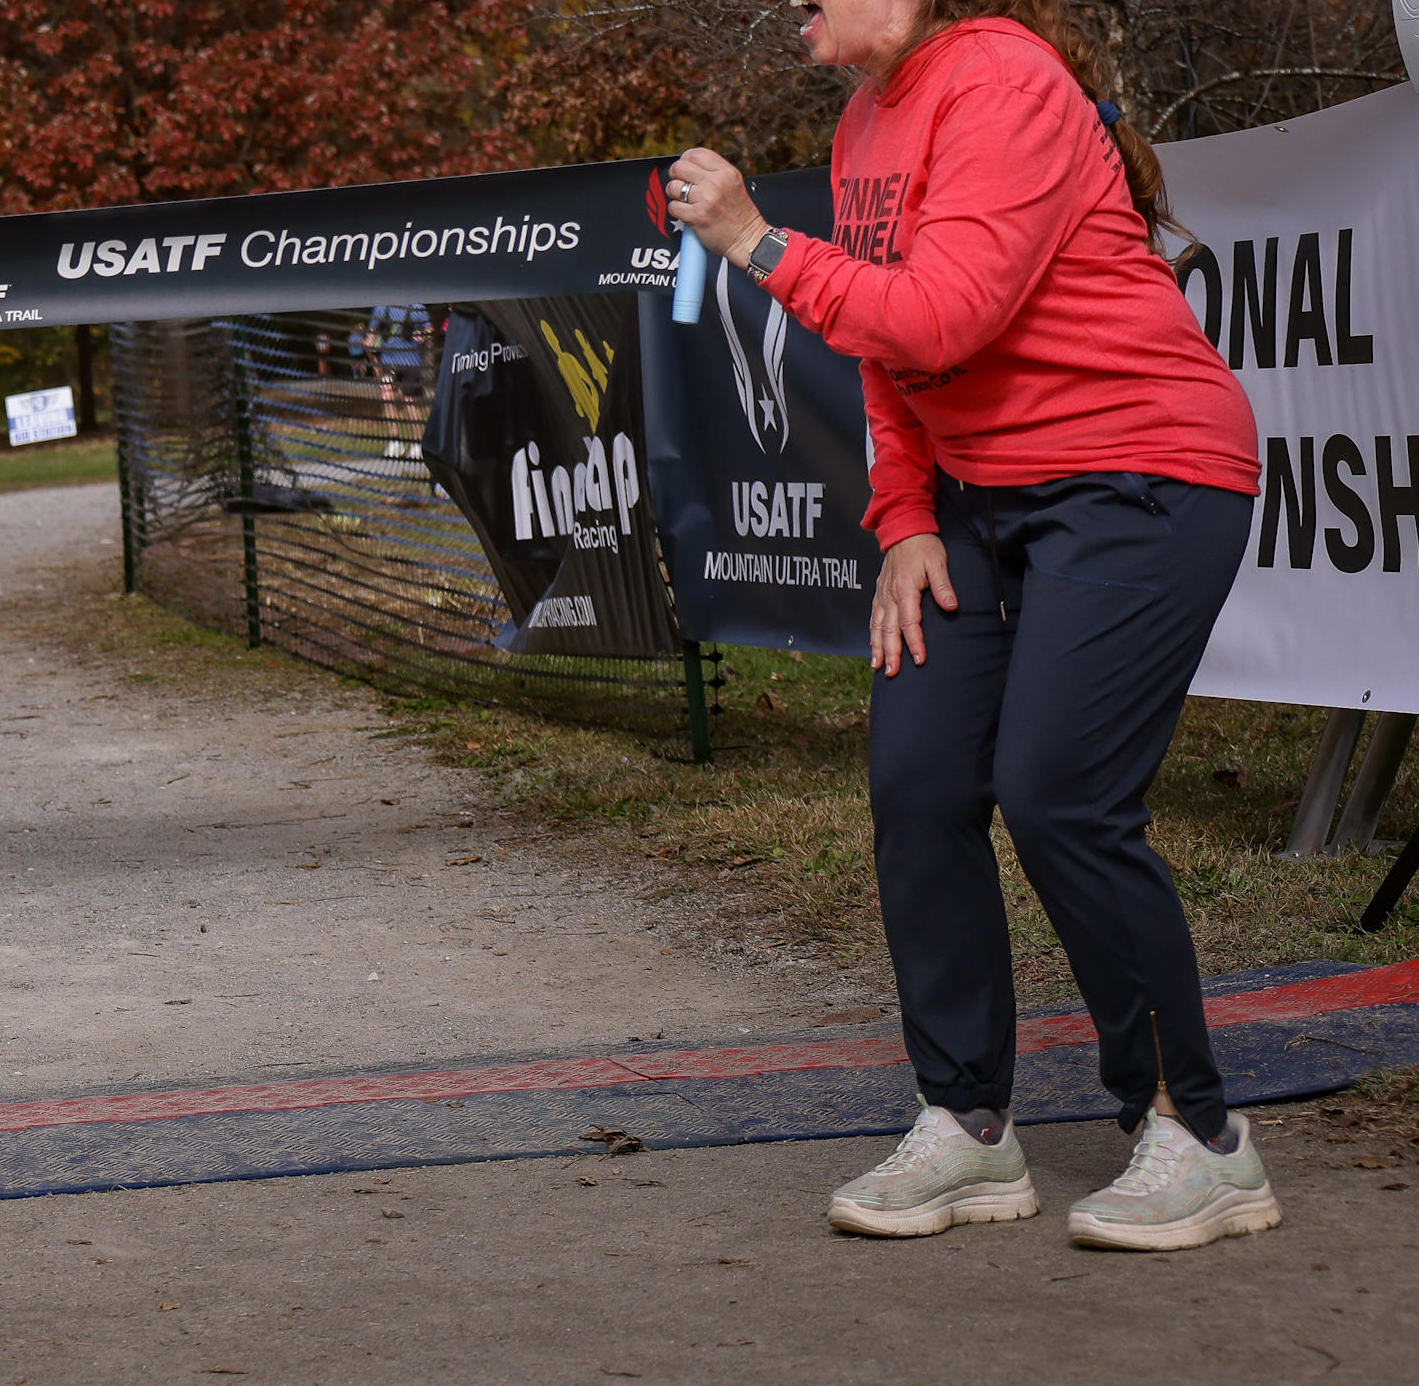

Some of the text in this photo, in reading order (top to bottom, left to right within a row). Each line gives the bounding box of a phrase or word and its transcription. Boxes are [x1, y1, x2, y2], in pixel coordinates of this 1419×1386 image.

[56, 215, 581, 279] USATF Championships
[598, 272, 670, 287] MOUNTAIN
[1179, 228, 1374, 371] ONAL
[5, 308, 43, 322] TRAIL
[732, 480, 824, 539] USATF
[573, 519, 619, 554] Racing
[704, 550, 862, 590] MOUNTAIN ULTRA TRAIL
